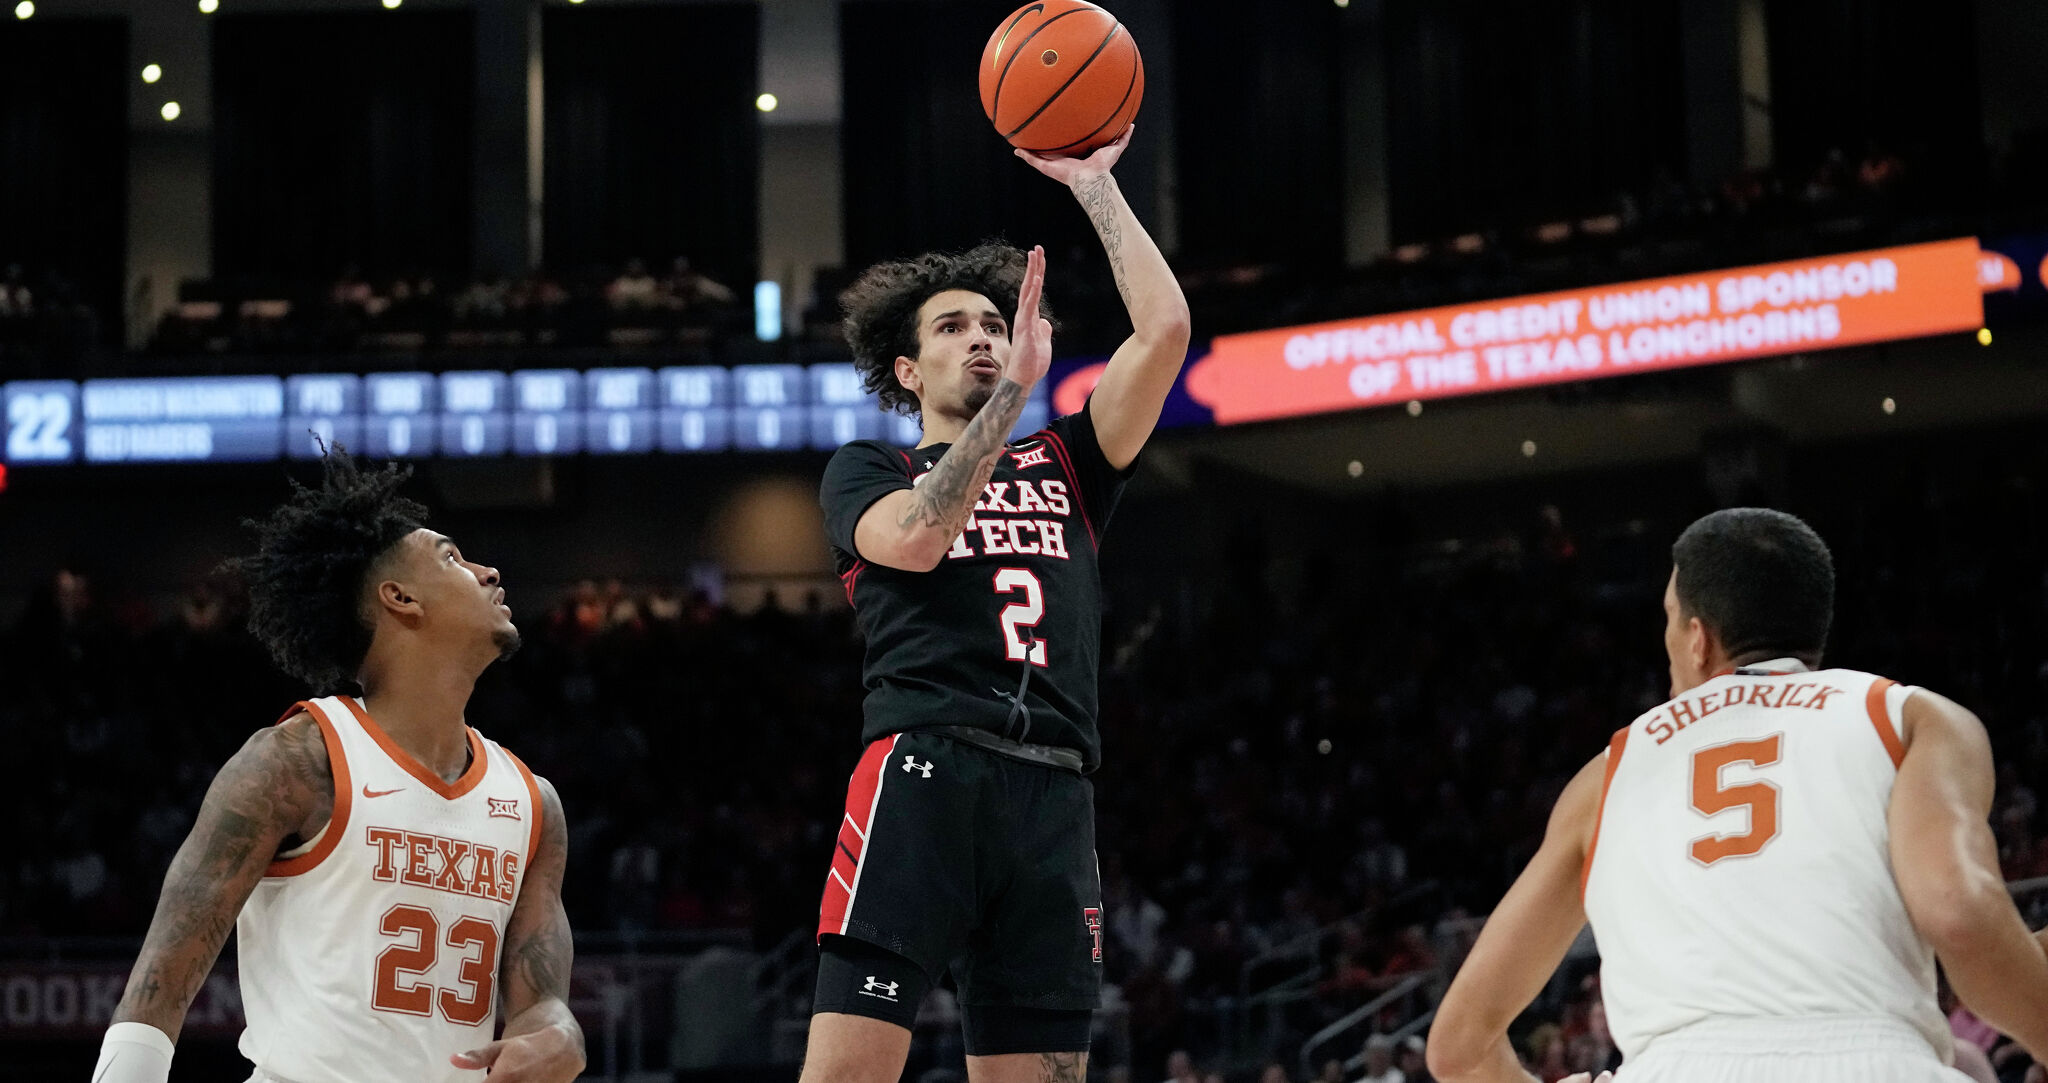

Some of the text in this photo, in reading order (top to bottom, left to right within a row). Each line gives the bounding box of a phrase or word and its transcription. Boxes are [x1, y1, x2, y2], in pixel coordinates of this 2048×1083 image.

[1284, 258, 1897, 371] OFFICIAL CREDIT UNION SPONSOR
[1348, 303, 1841, 399] OF THE TEXAS LONGHORNS
[10, 393, 70, 457] 22
[1009, 444, 1052, 470] XII
[993, 567, 1048, 667] 2
[1645, 682, 1845, 746] SHEDRICK
[1687, 731, 1784, 869] 5
[367, 825, 520, 906] TEXAS
[371, 903, 500, 1028] 23
